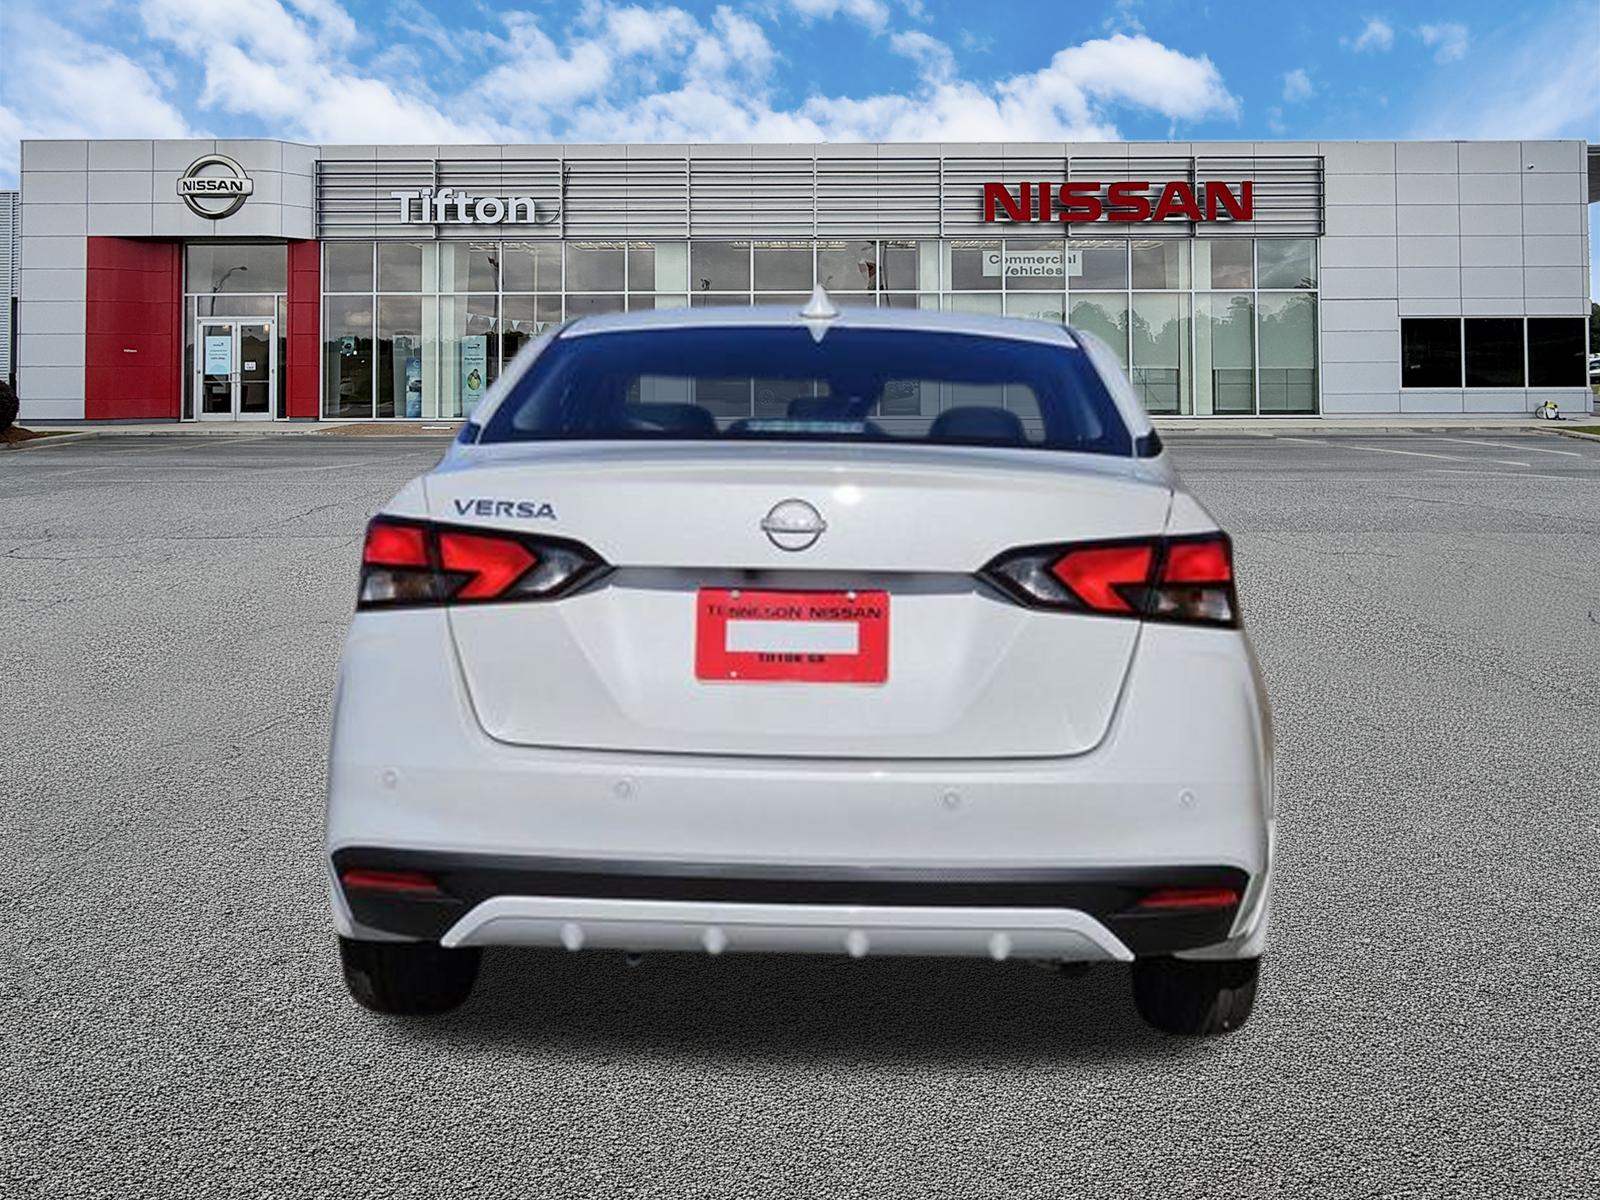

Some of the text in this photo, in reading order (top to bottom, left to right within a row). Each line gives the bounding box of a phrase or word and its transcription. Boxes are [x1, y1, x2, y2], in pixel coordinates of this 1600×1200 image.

[182, 180, 243, 191] NISSAN
[391, 187, 536, 224] Tifton
[983, 181, 1253, 222] NISSAN
[988, 254, 1076, 264] Cmmercil
[453, 498, 557, 521] VERSA
[809, 606, 882, 619] NISSAN
